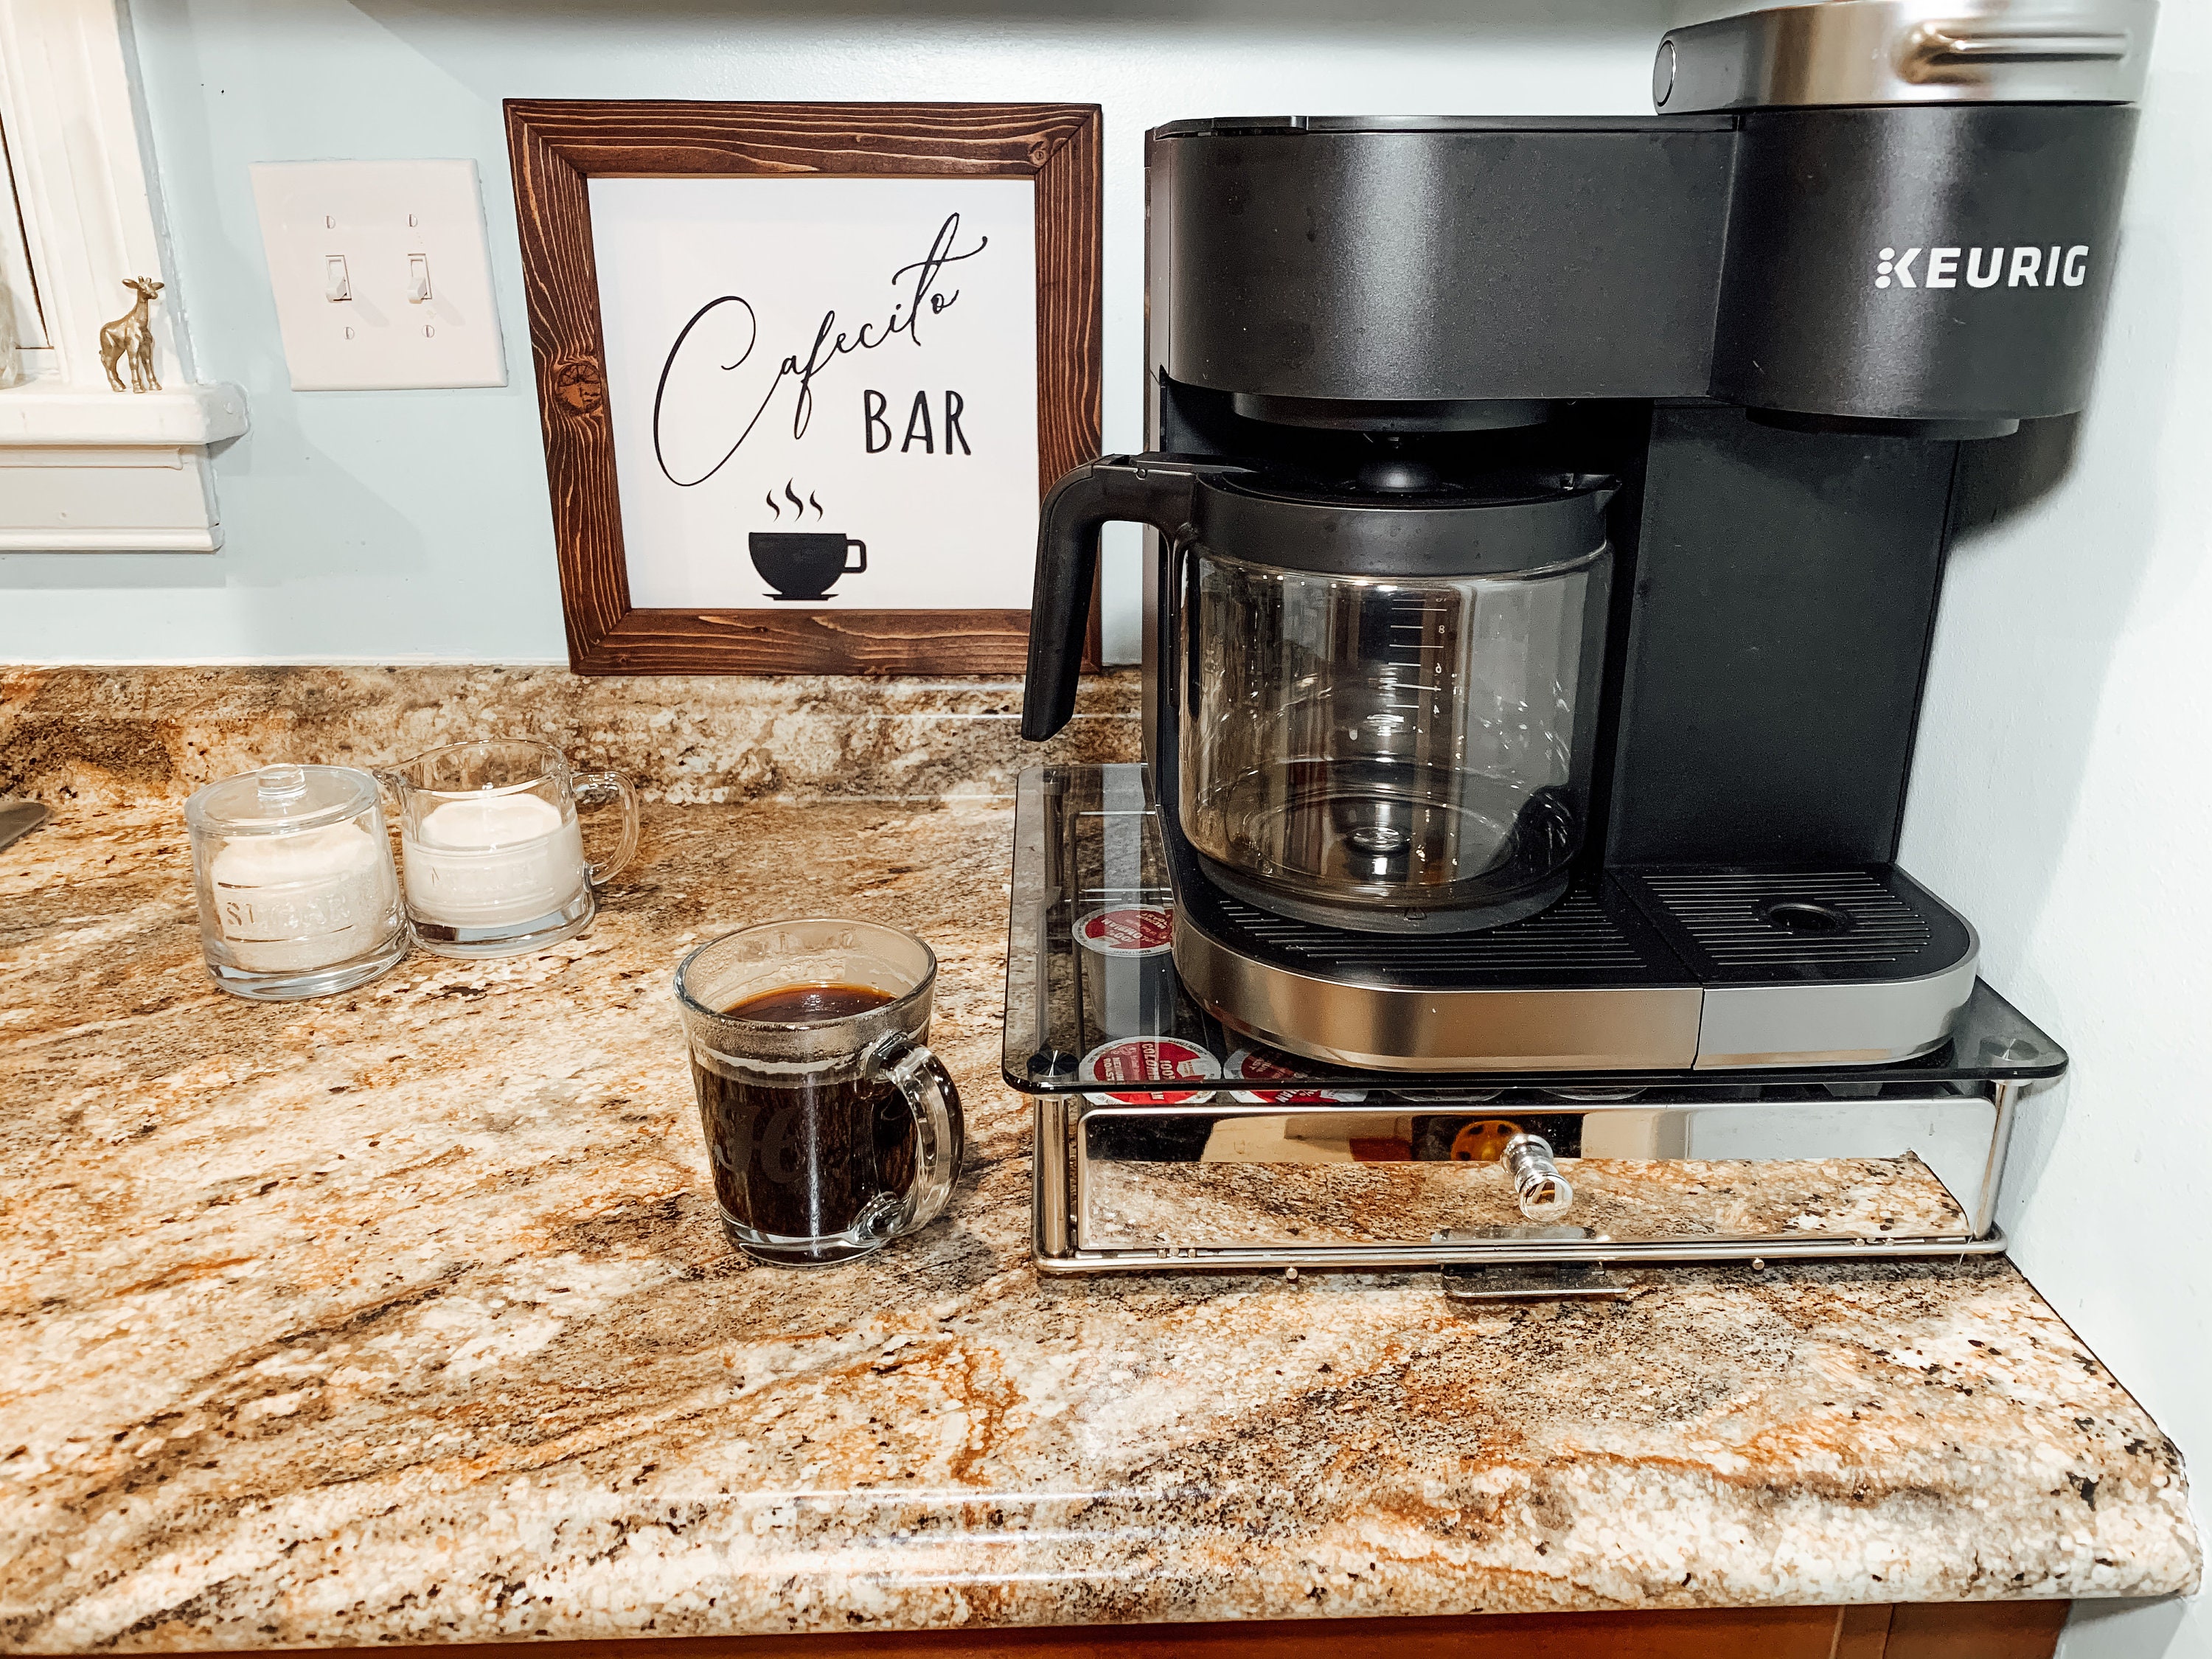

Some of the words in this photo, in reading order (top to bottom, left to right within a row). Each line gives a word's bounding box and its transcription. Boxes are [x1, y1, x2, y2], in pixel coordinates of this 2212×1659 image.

[1875, 246, 2089, 288] KEURIG
[653, 212, 987, 487] Cafecito
[863, 389, 972, 456] BAR
